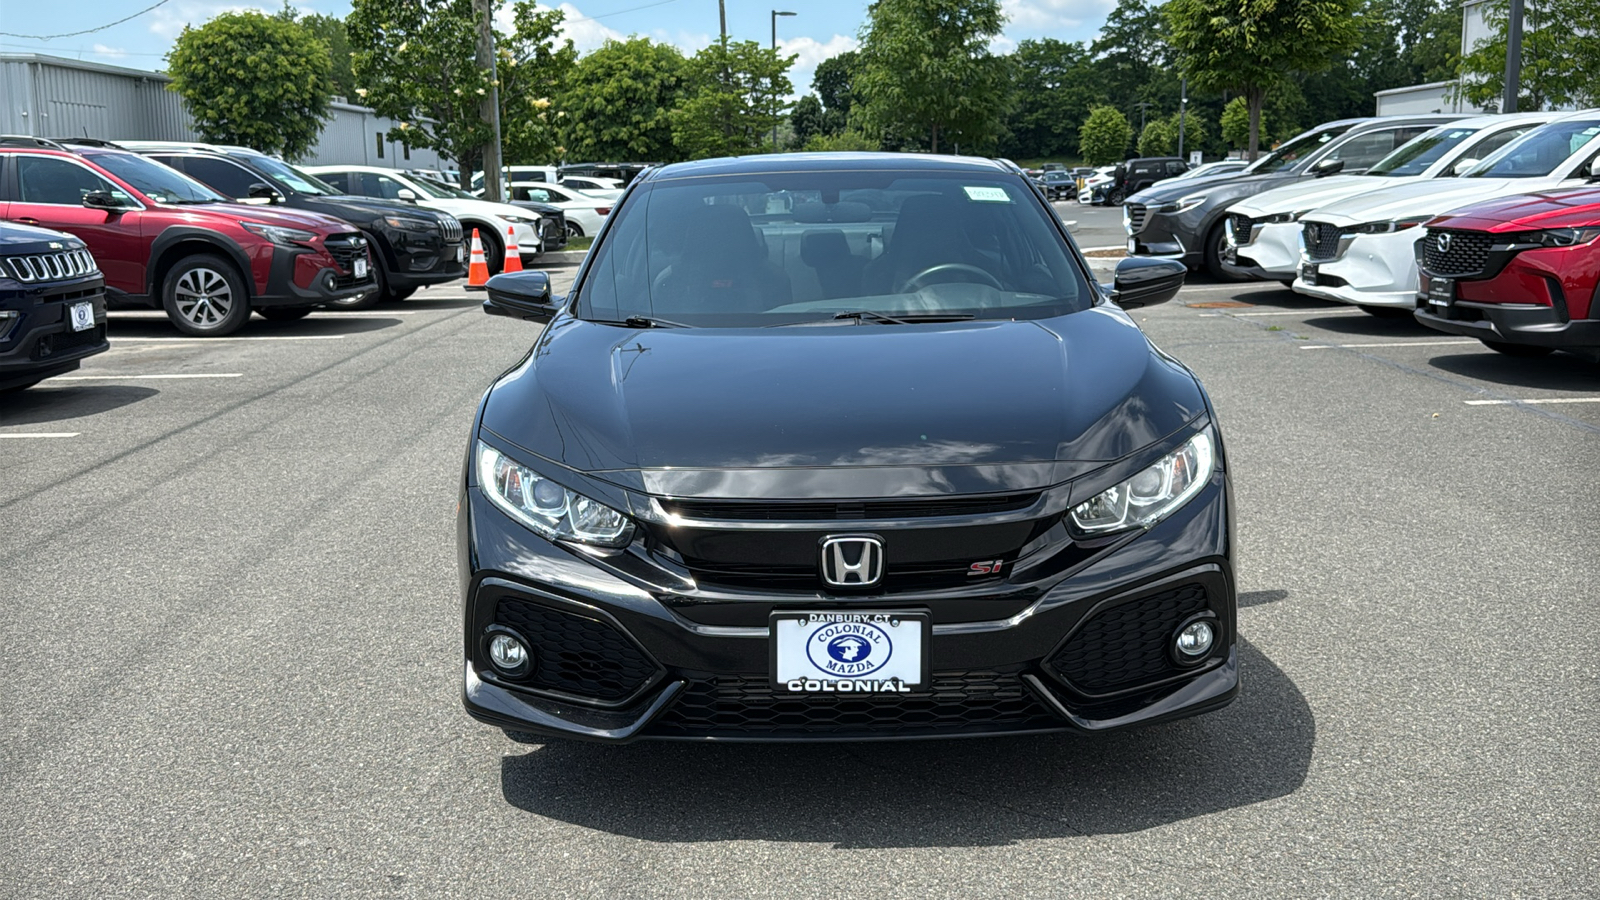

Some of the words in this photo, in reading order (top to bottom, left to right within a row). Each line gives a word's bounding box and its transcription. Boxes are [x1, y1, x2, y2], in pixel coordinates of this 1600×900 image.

[809, 613, 870, 624] DANBURY,
[873, 614, 891, 623] CT
[817, 624, 882, 645] COLONIAL
[825, 659, 875, 674] MAZDA
[787, 679, 911, 692] COLONIAL
